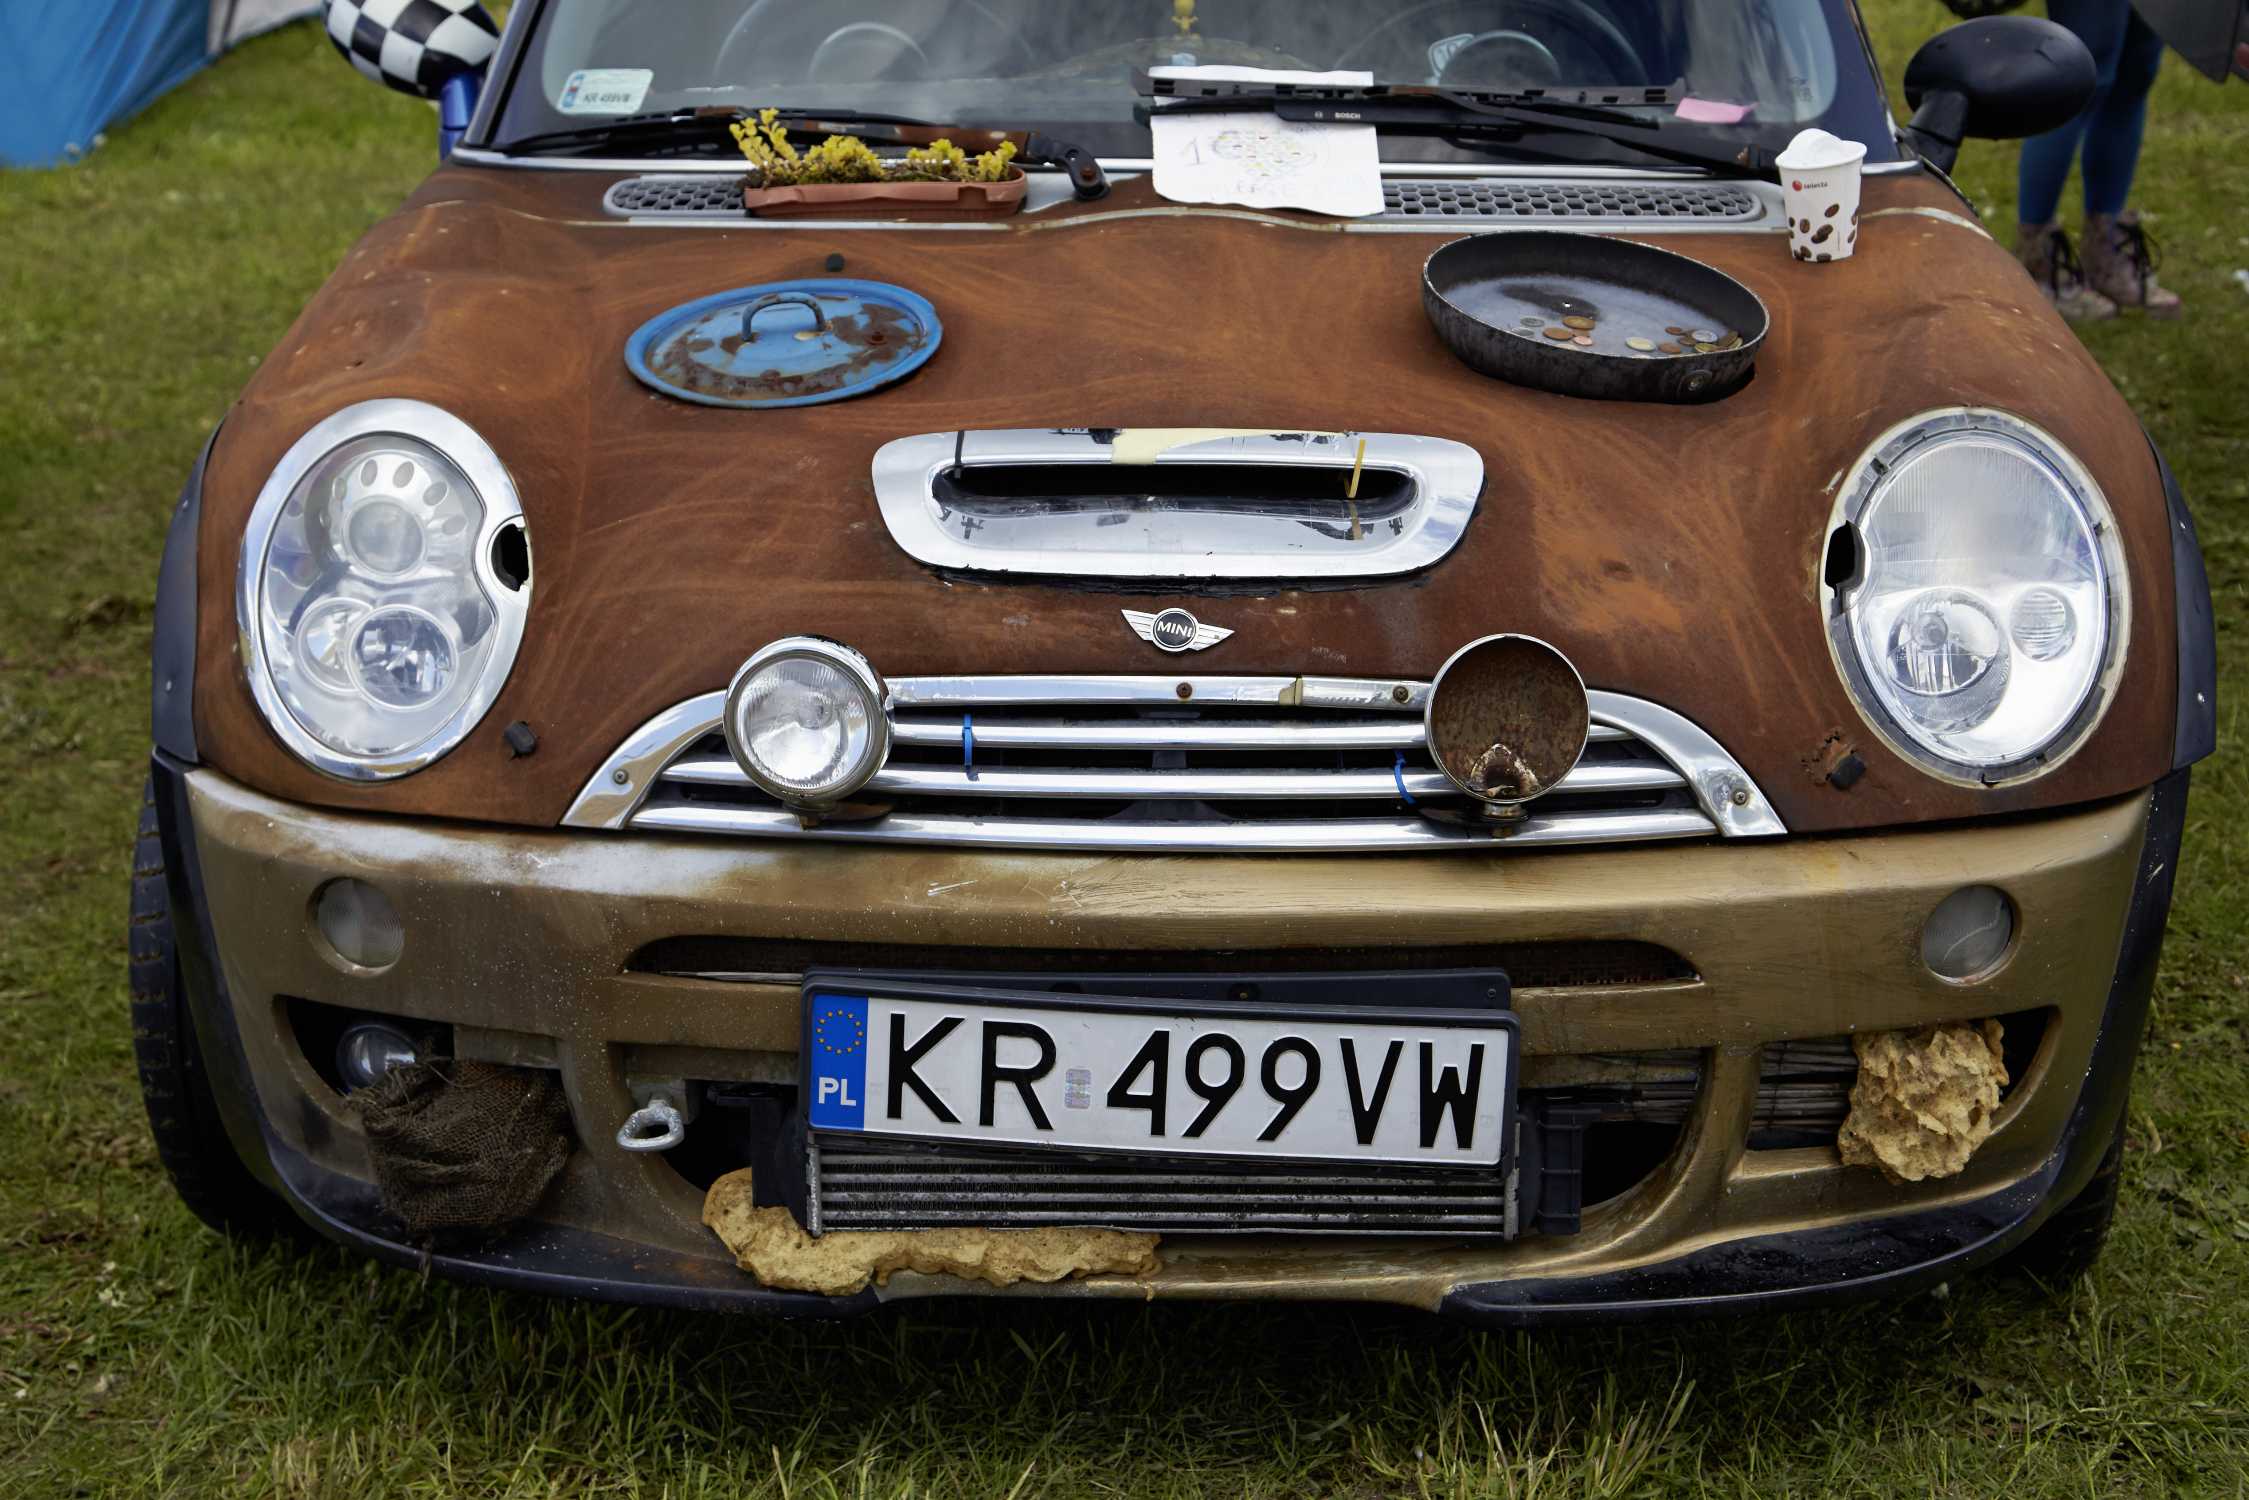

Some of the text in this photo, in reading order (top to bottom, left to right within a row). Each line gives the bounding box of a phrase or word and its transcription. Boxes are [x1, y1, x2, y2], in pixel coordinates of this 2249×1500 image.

[1335, 111, 1361, 120] BOSCH
[1157, 620, 1194, 638] MINI
[818, 1076, 857, 1107] PL
[886, 1011, 1486, 1151] KR 499VW
